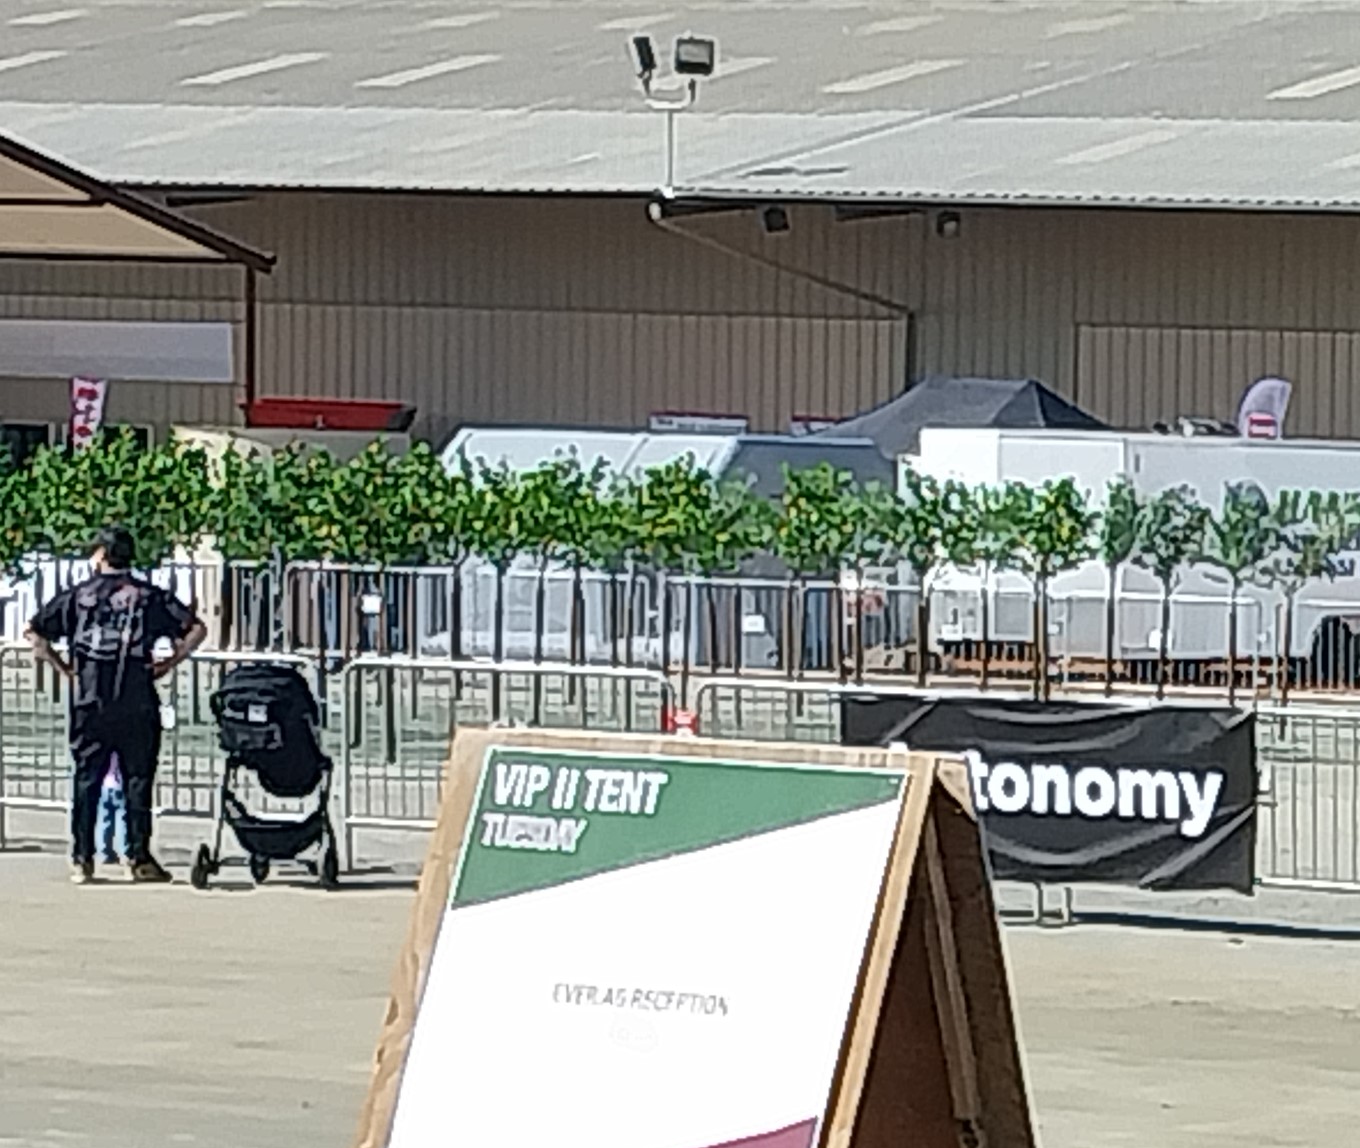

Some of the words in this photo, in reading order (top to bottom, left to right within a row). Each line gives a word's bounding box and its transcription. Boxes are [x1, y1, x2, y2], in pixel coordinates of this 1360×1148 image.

[494, 763, 549, 807] VIP
[552, 767, 580, 810] II
[584, 769, 669, 815] TENT
[967, 750, 1224, 838] tonomy
